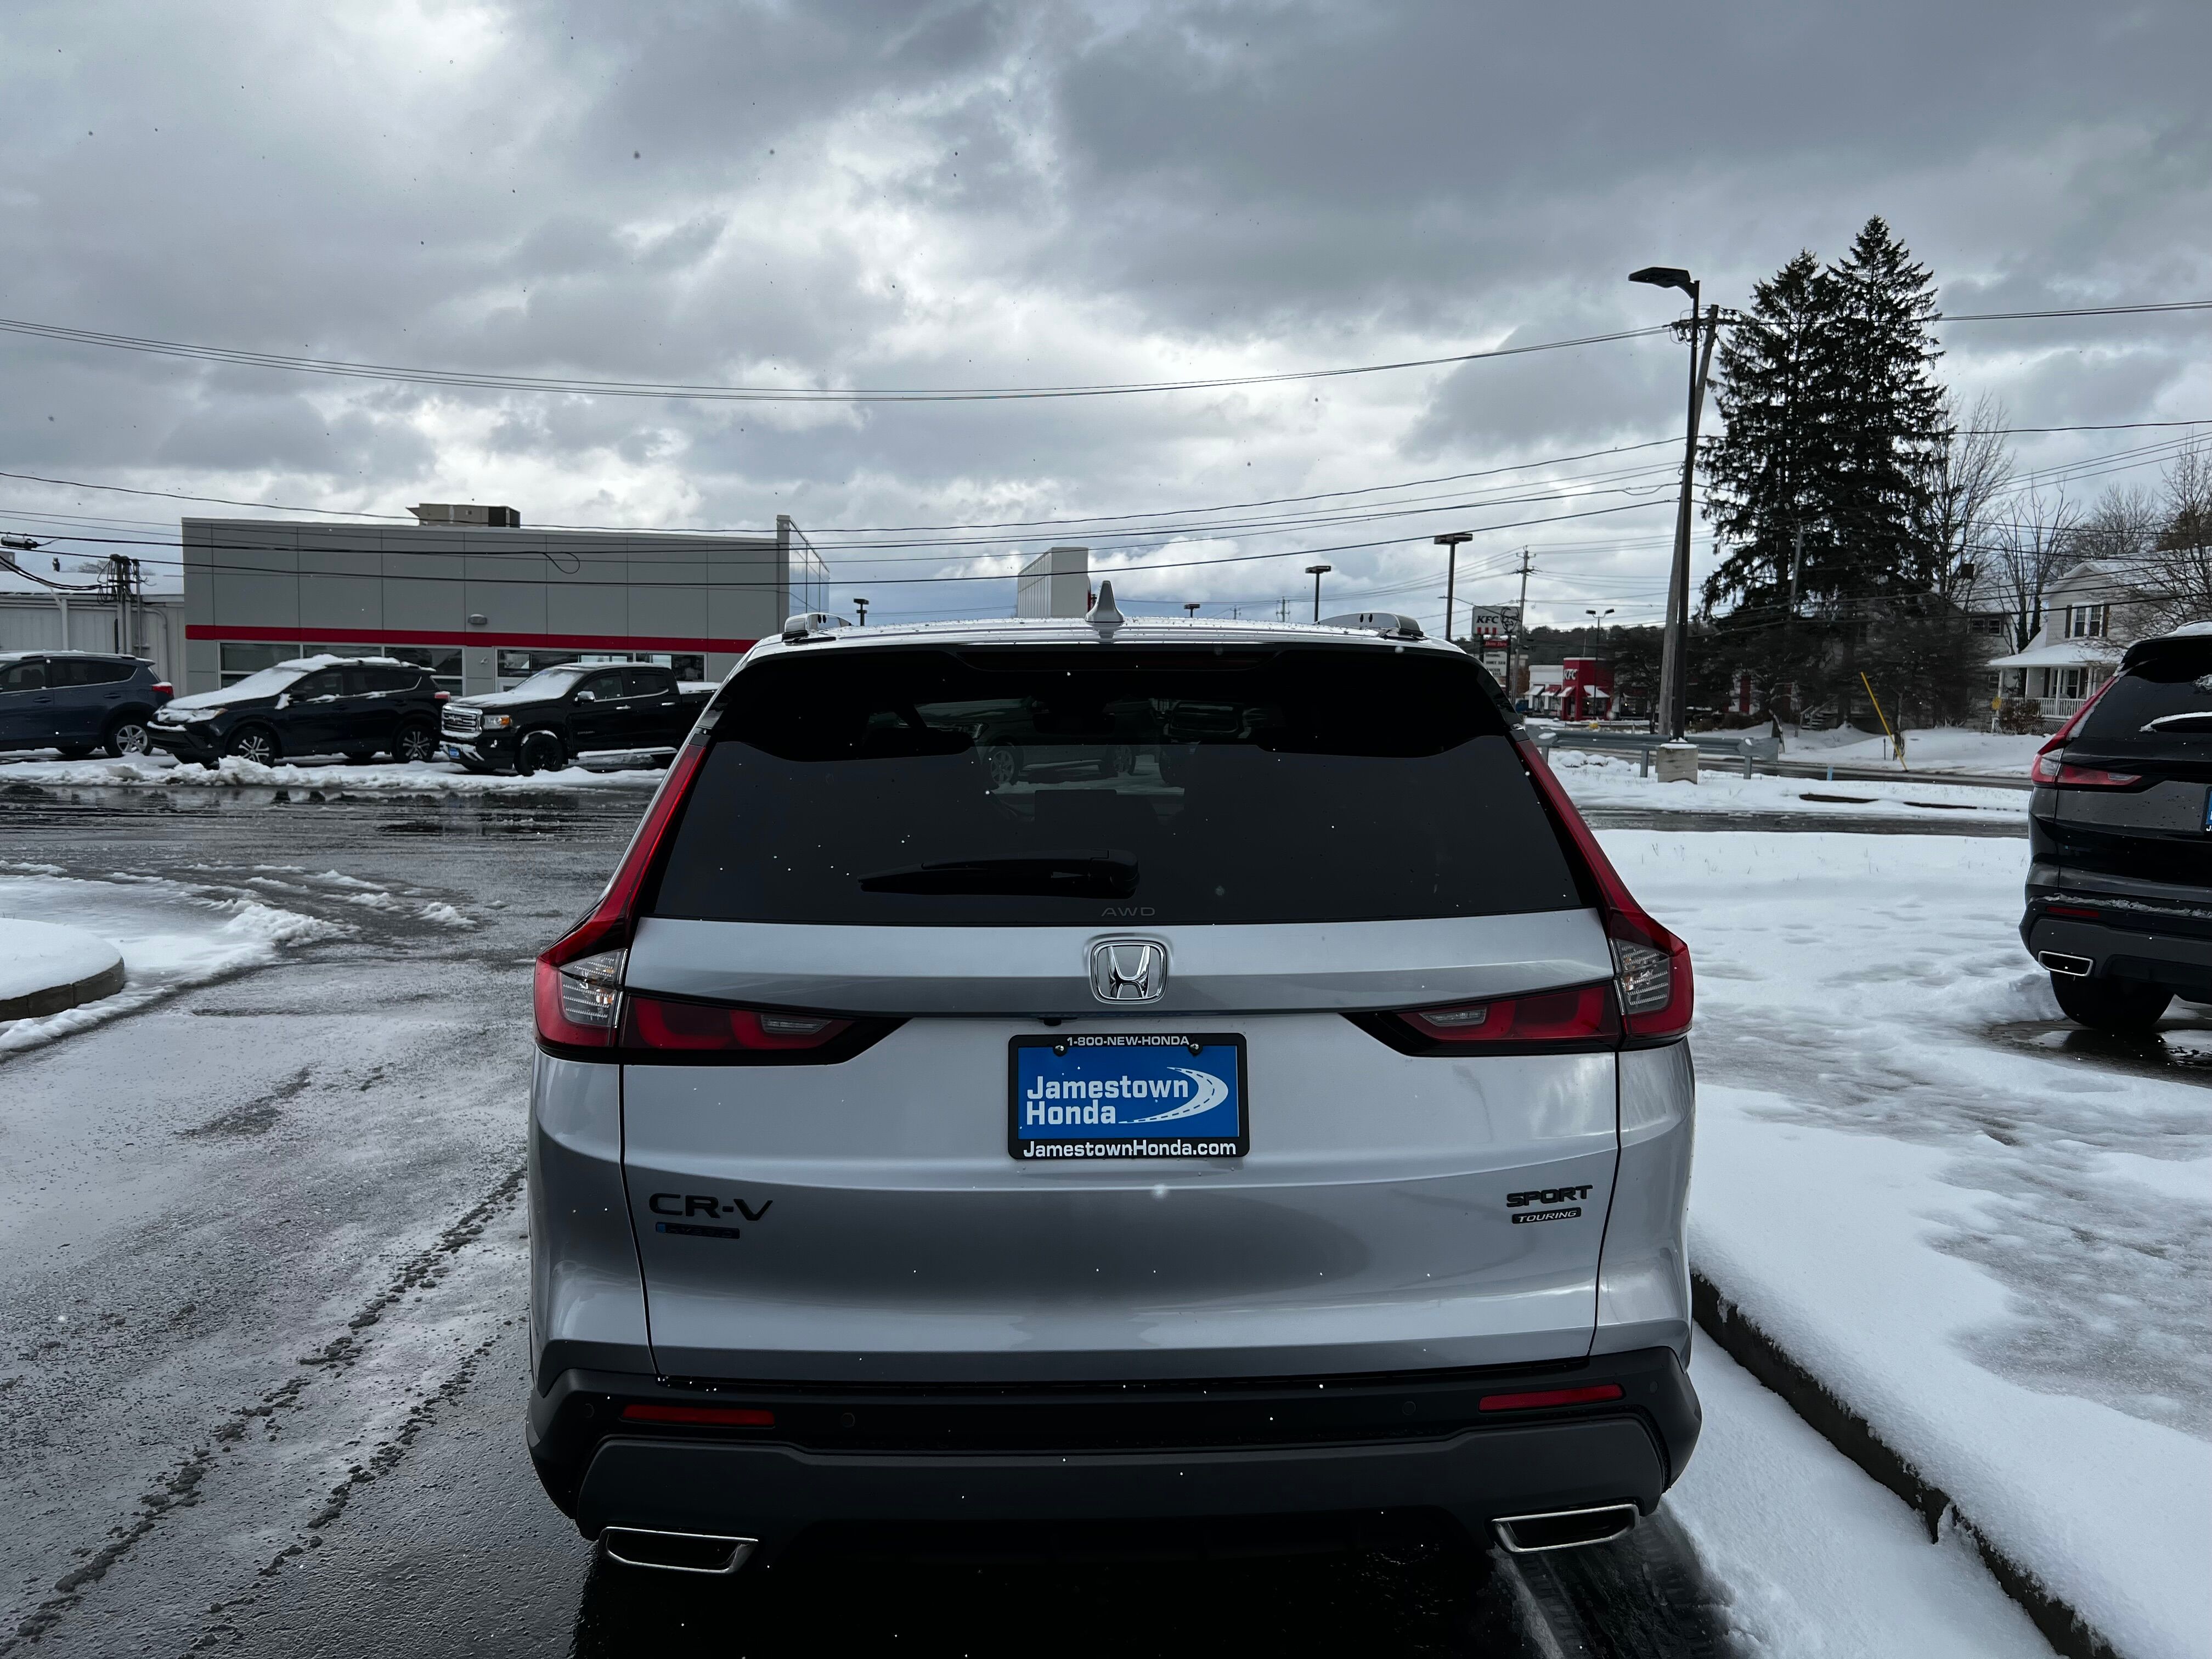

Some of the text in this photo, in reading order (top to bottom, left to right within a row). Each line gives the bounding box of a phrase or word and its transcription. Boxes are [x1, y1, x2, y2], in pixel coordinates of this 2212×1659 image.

[1563, 669, 1577, 680] KFC
[1101, 907, 1155, 917] AWD
[1066, 1035, 1190, 1046] 1-800-NEW-HONDA
[1027, 1075, 1189, 1099] Jamestown
[1026, 1099, 1116, 1125] Honda
[1023, 1139, 1236, 1158] JamestownHonda.com
[1506, 1184, 1593, 1207] SPORT
[649, 1193, 773, 1221] CR-V
[1519, 1210, 1577, 1222] TOURING
